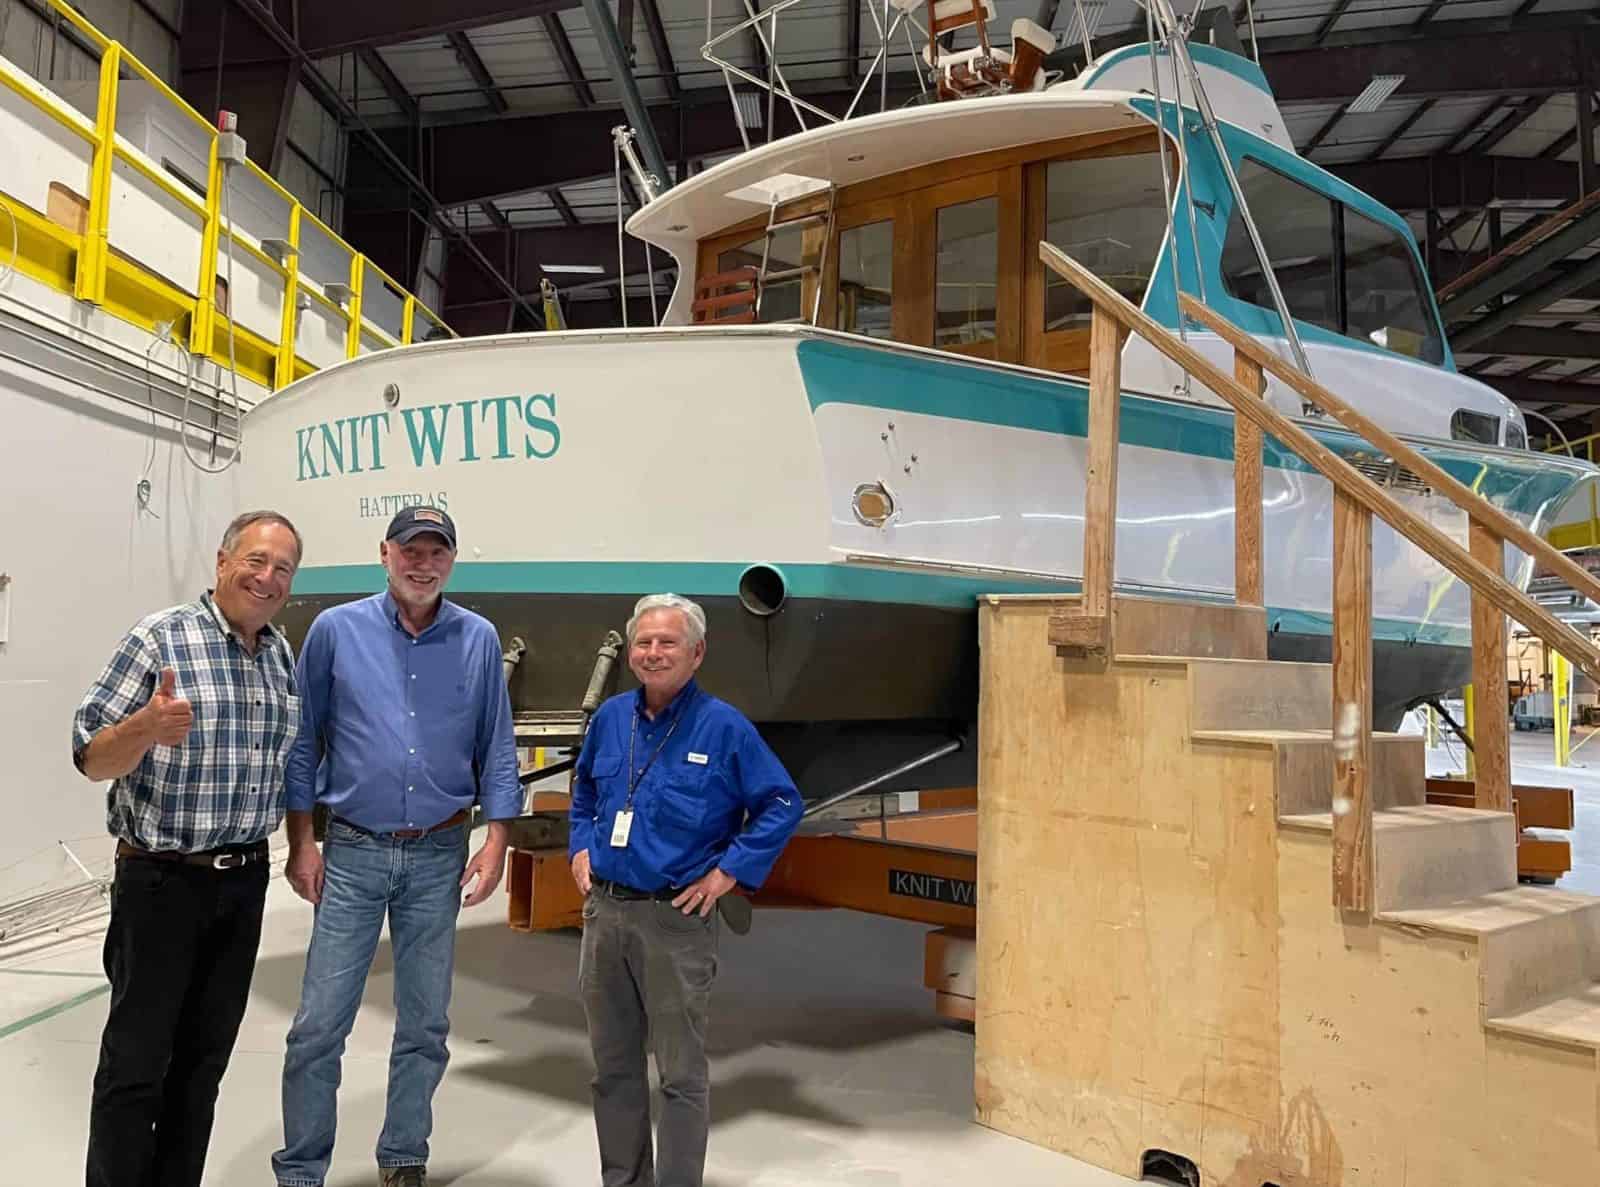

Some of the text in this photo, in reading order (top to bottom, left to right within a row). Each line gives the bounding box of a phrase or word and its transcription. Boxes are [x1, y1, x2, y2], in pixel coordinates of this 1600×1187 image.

[296, 392, 561, 482] KNIT WITS
[360, 491, 448, 517] HATTERAS
[896, 871, 945, 899] KNIT
